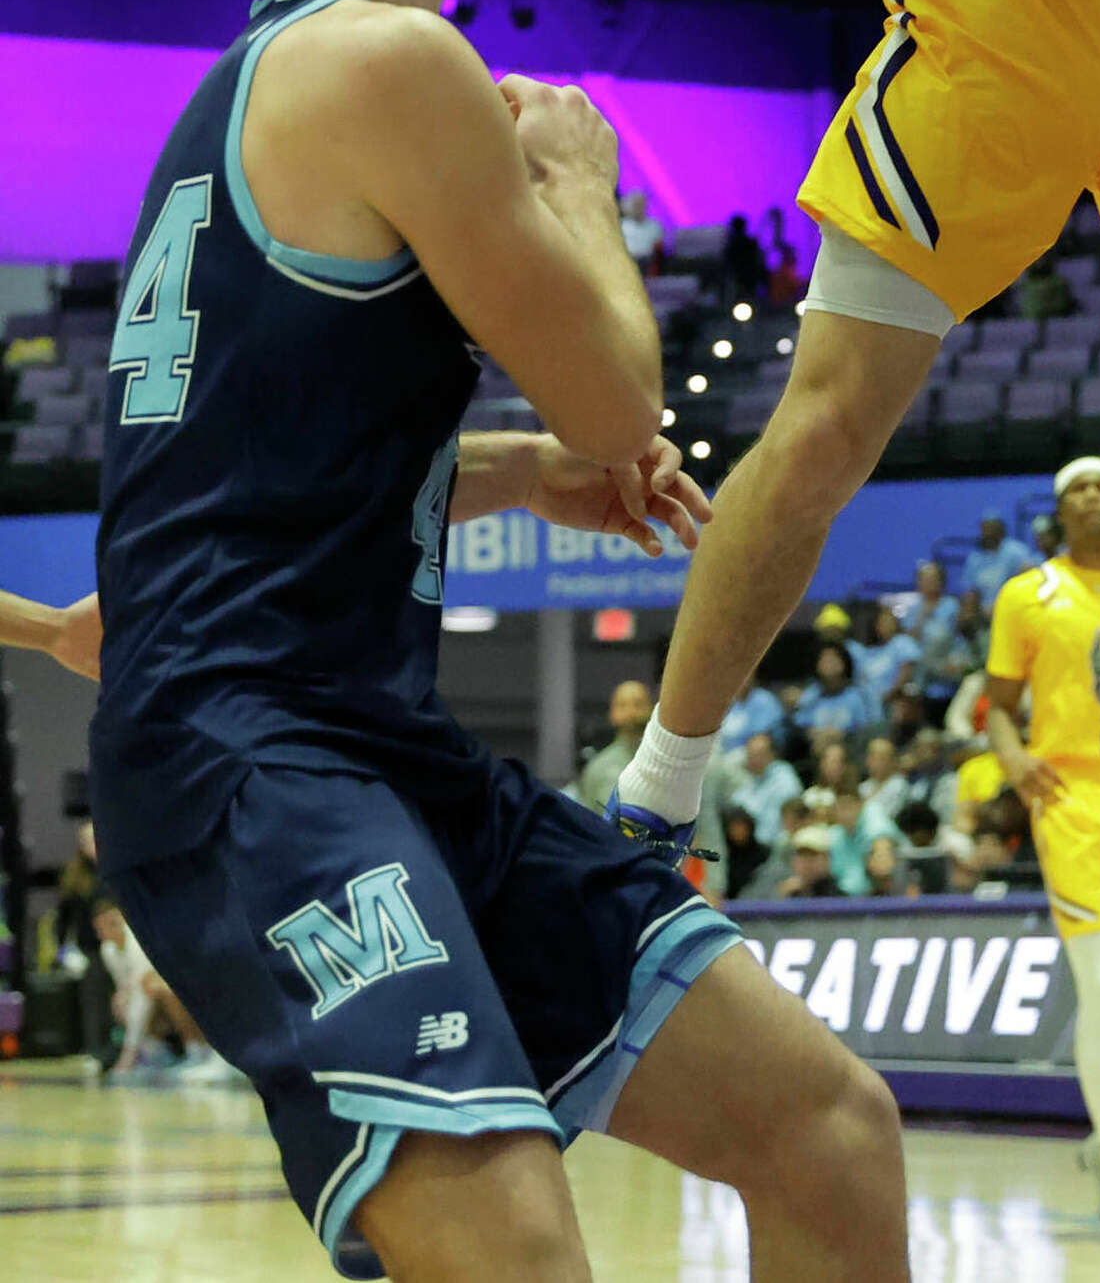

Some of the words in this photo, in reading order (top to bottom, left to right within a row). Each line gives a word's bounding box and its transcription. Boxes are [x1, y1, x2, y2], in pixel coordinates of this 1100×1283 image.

[108, 173, 213, 425] 4
[265, 862, 450, 1020] M
[744, 936, 1061, 1036] EATIVE
